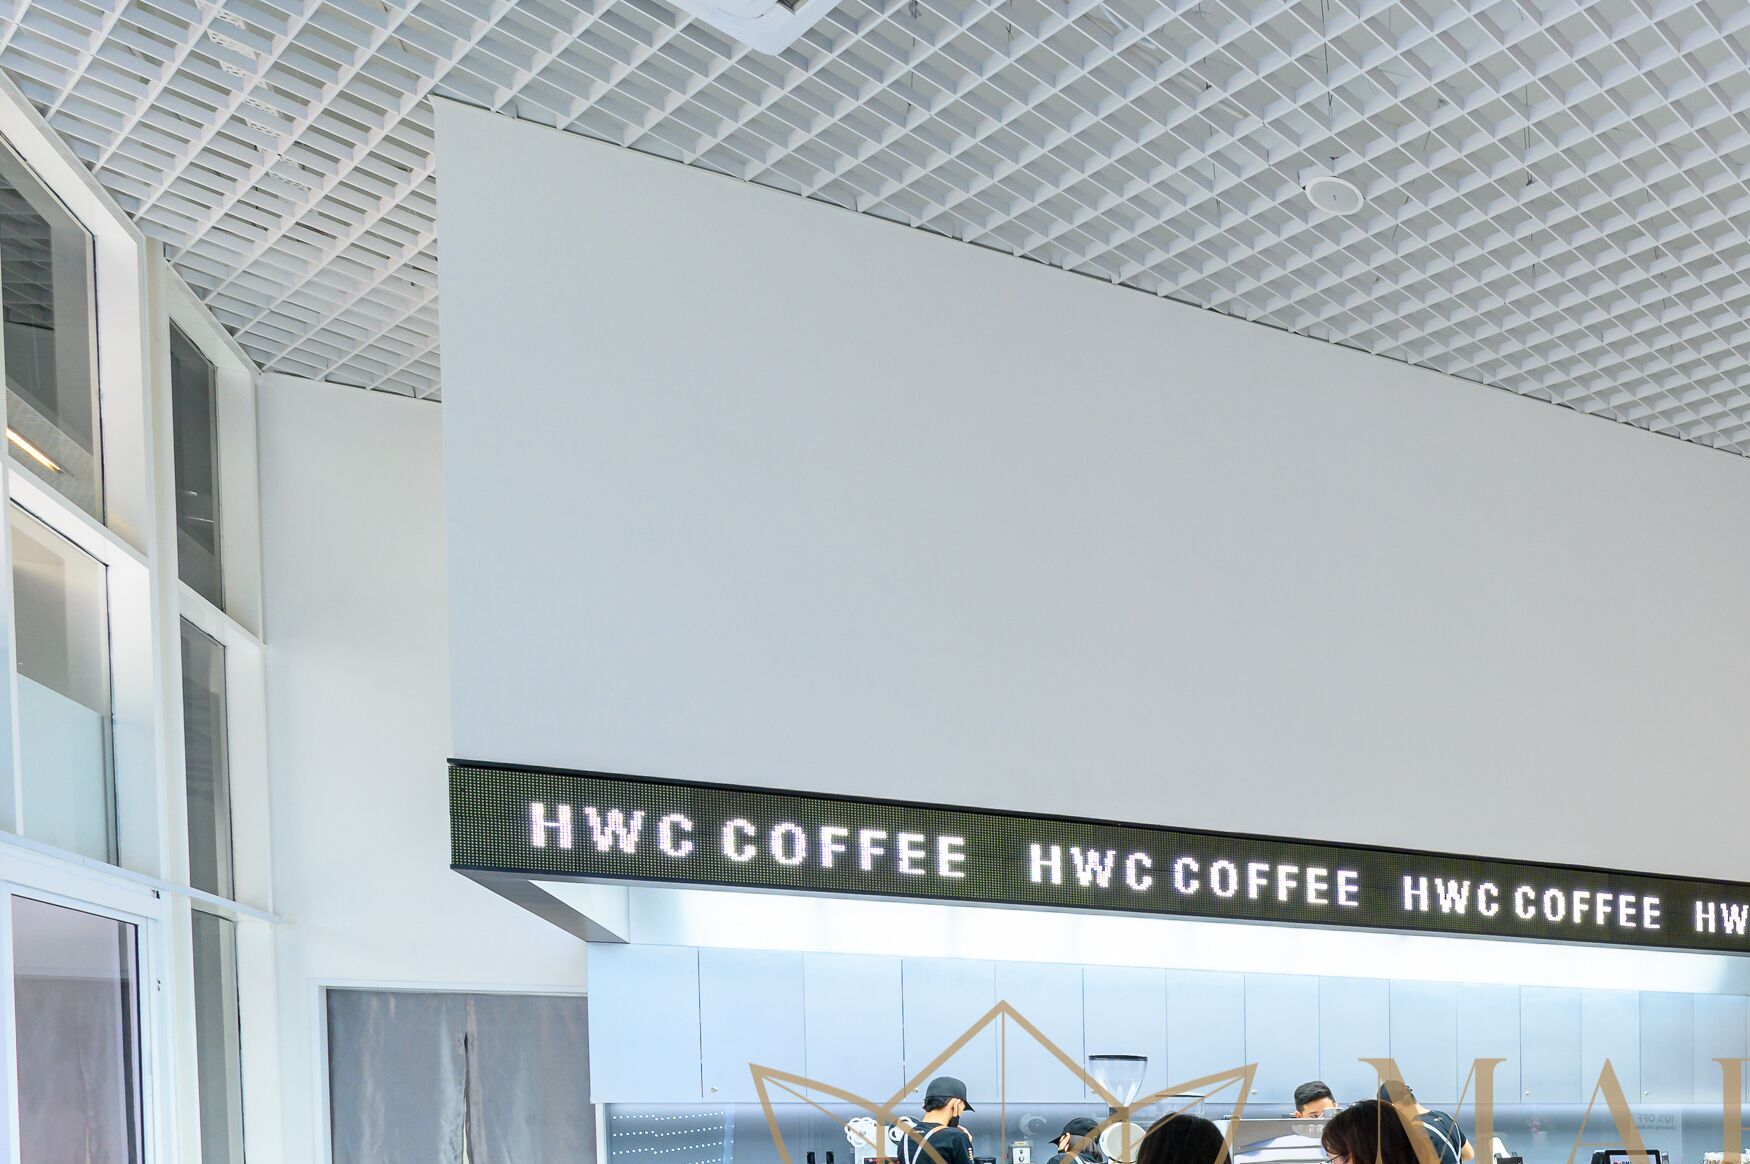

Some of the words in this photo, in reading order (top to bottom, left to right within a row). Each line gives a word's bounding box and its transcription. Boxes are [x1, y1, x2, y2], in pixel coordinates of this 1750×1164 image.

[532, 803, 693, 857] HWC
[723, 819, 966, 879] COFFEE
[1031, 844, 1153, 891] HWC
[1174, 858, 1359, 907] COFFEE
[1405, 877, 1499, 917] HWC
[1515, 886, 1661, 929] COFFEE
